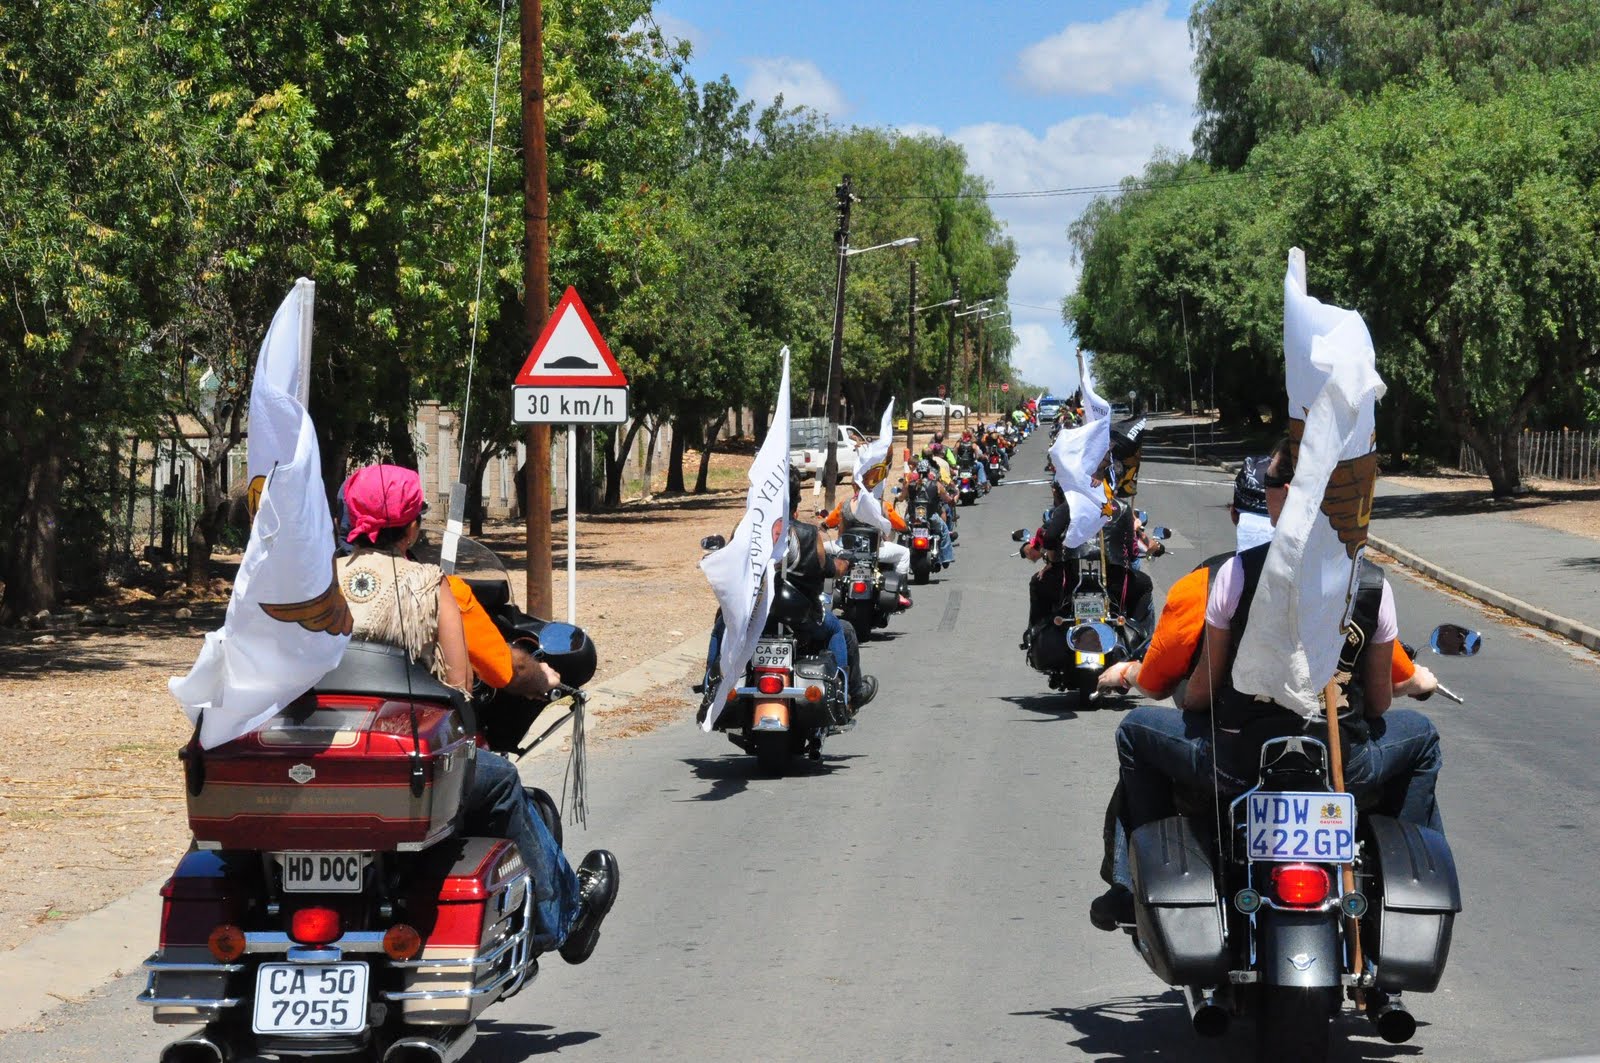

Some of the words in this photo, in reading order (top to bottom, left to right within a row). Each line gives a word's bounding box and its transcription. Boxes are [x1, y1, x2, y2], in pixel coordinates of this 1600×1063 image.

[528, 394, 549, 415] 30
[560, 394, 613, 416] km/h
[755, 645, 773, 655] CA
[775, 646, 789, 655] 58
[758, 656, 785, 665] 9787
[1253, 798, 1310, 825] WDW
[1252, 829, 1352, 856] 422GP
[288, 856, 314, 882] HD
[319, 856, 358, 882] DOC
[269, 969, 307, 995] CA
[319, 969, 356, 995] 50
[272, 1000, 350, 1027] 7955
